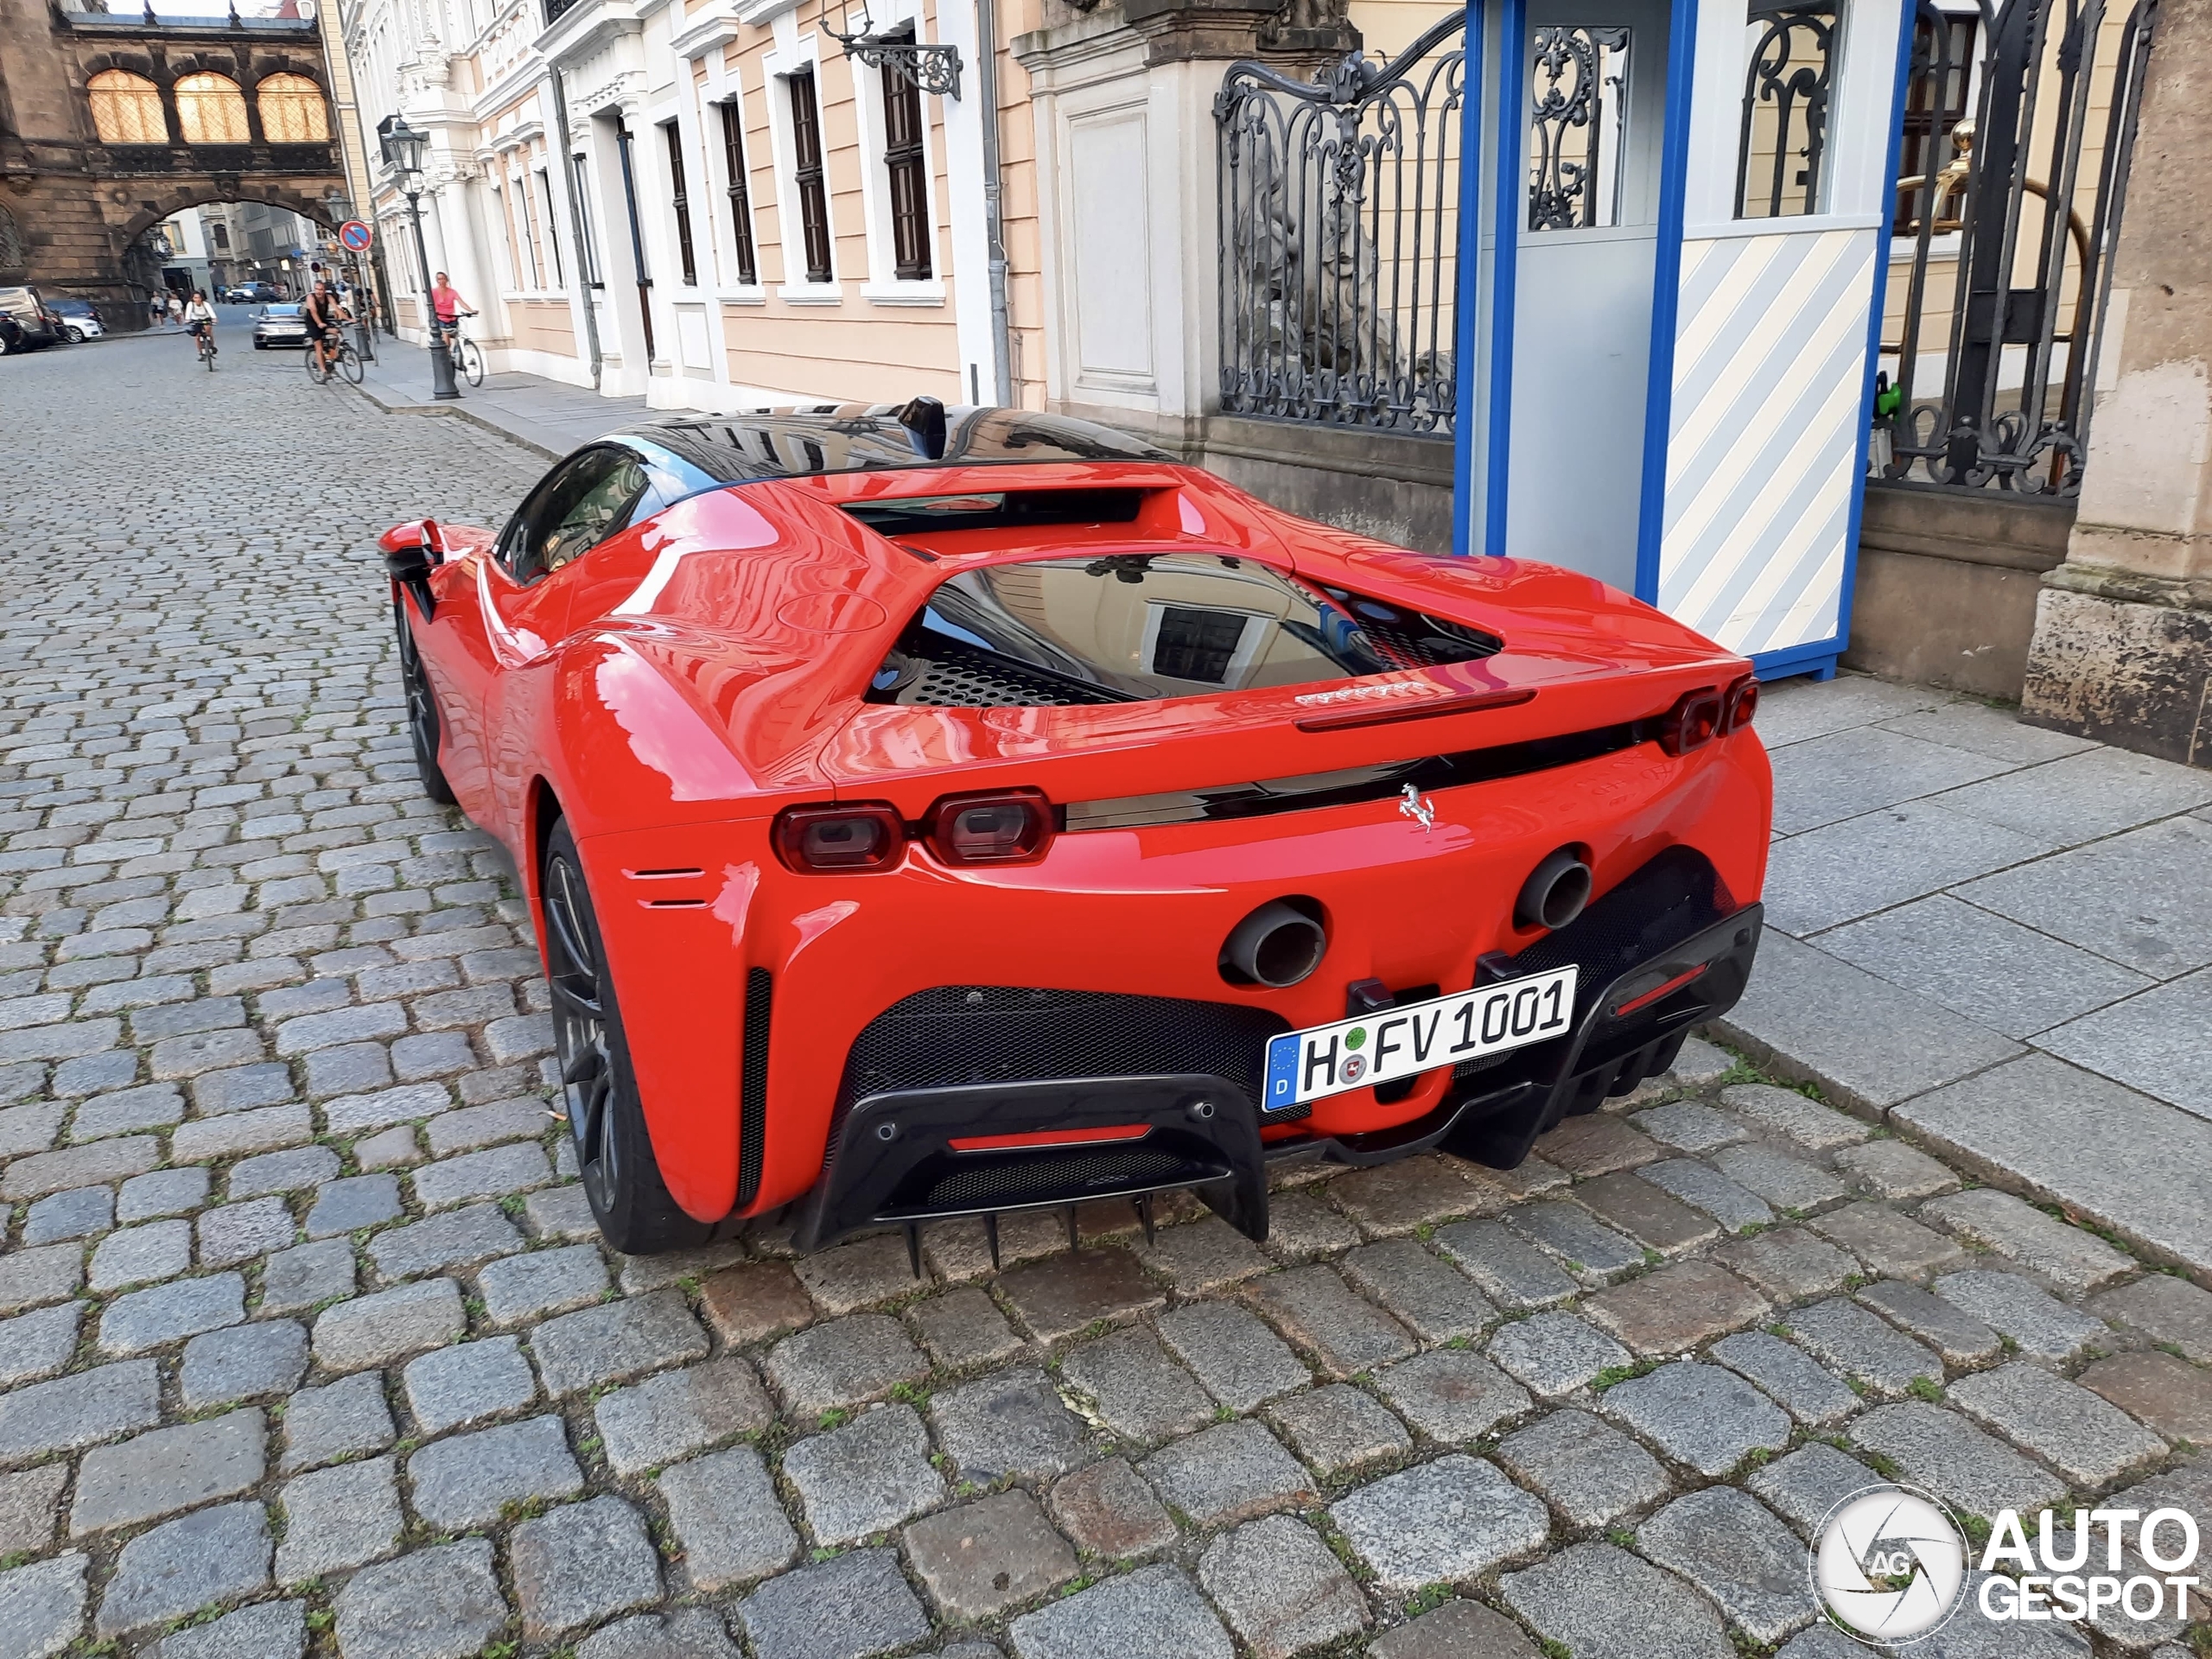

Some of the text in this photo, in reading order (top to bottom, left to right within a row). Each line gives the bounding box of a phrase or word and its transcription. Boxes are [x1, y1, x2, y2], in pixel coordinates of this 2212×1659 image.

[1304, 980, 1565, 1091] H FV 1001
[1275, 1078, 1288, 1095] D
